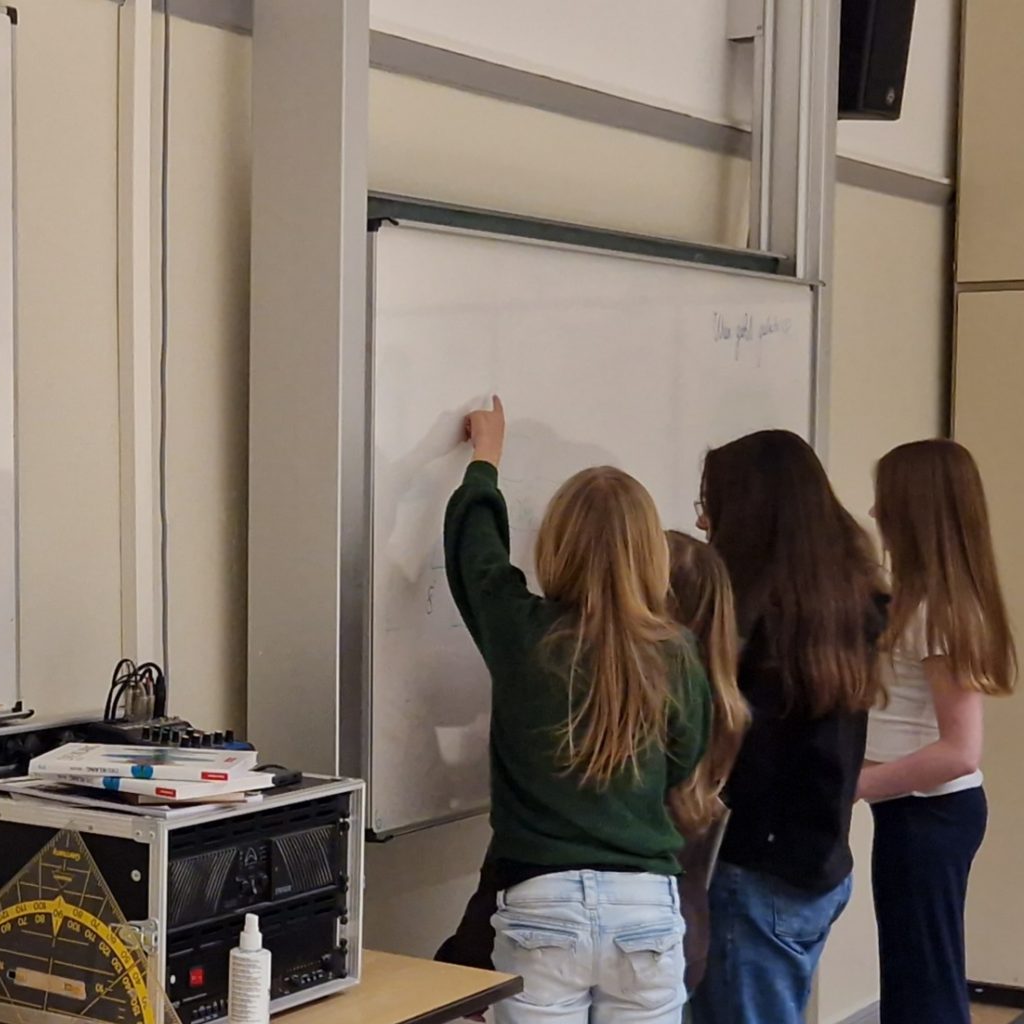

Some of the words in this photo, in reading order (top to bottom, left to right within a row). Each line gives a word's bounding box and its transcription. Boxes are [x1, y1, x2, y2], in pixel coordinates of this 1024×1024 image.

[15, 904, 28, 914] 110
[32, 902, 47, 911] 100
[53, 908, 64, 919] 90
[72, 908, 83, 918] 80
[17, 917, 28, 926] 70
[34, 914, 46, 924] 80
[90, 918, 102, 929] 70
[0, 922, 12, 934] 60
[66, 920, 81, 933] 100
[84, 929, 97, 943] 110
[98, 941, 111, 957] 120
[111, 957, 123, 974] 130
